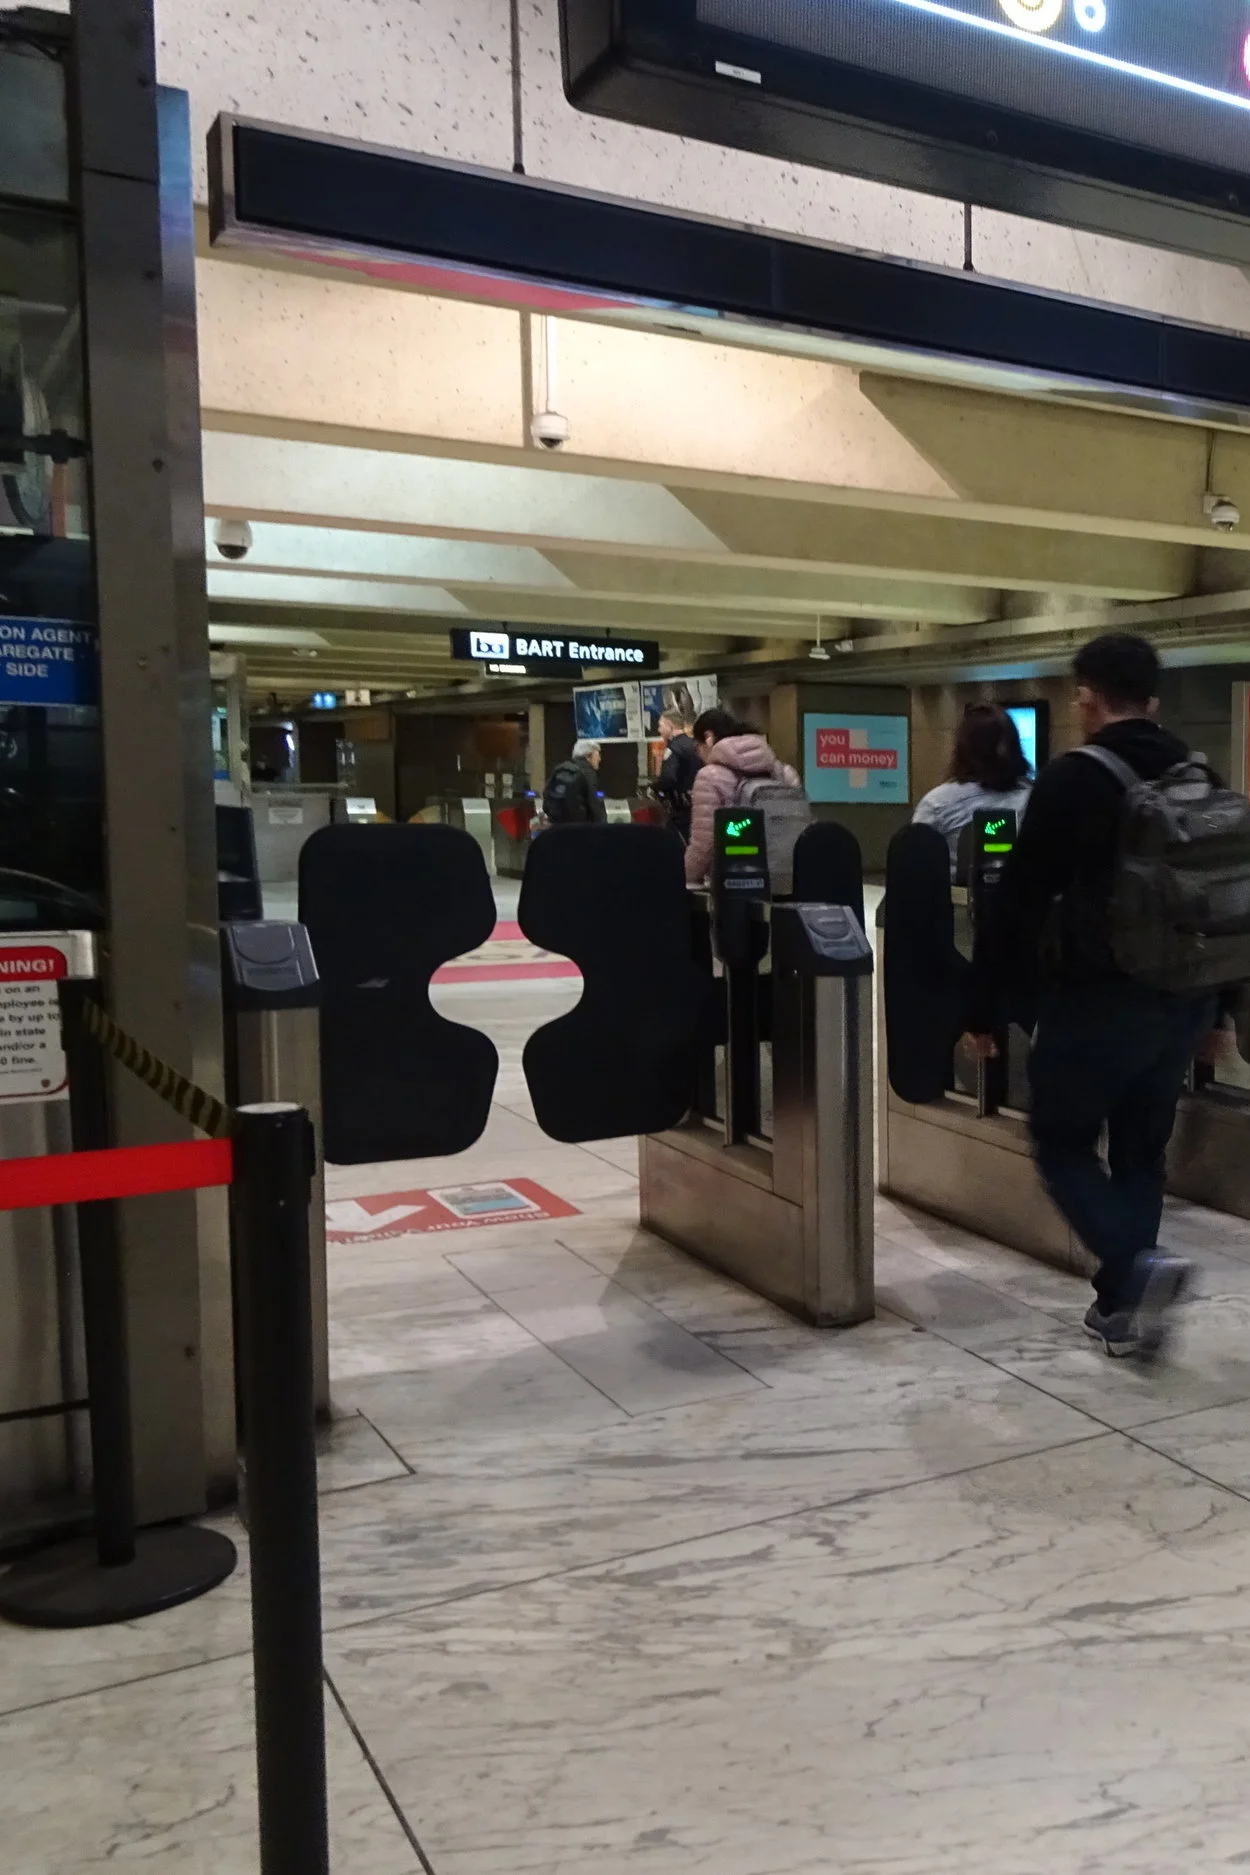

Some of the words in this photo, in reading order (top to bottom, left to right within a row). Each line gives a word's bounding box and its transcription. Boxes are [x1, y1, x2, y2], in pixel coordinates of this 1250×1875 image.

[31, 627, 92, 644] AGENT
[0, 643, 75, 662] REGATE
[515, 638, 565, 658] BART
[568, 641, 645, 663] Entrance
[6, 662, 49, 678] SIDE
[819, 734, 846, 748] you
[819, 754, 846, 764] can
[848, 753, 895, 768] money
